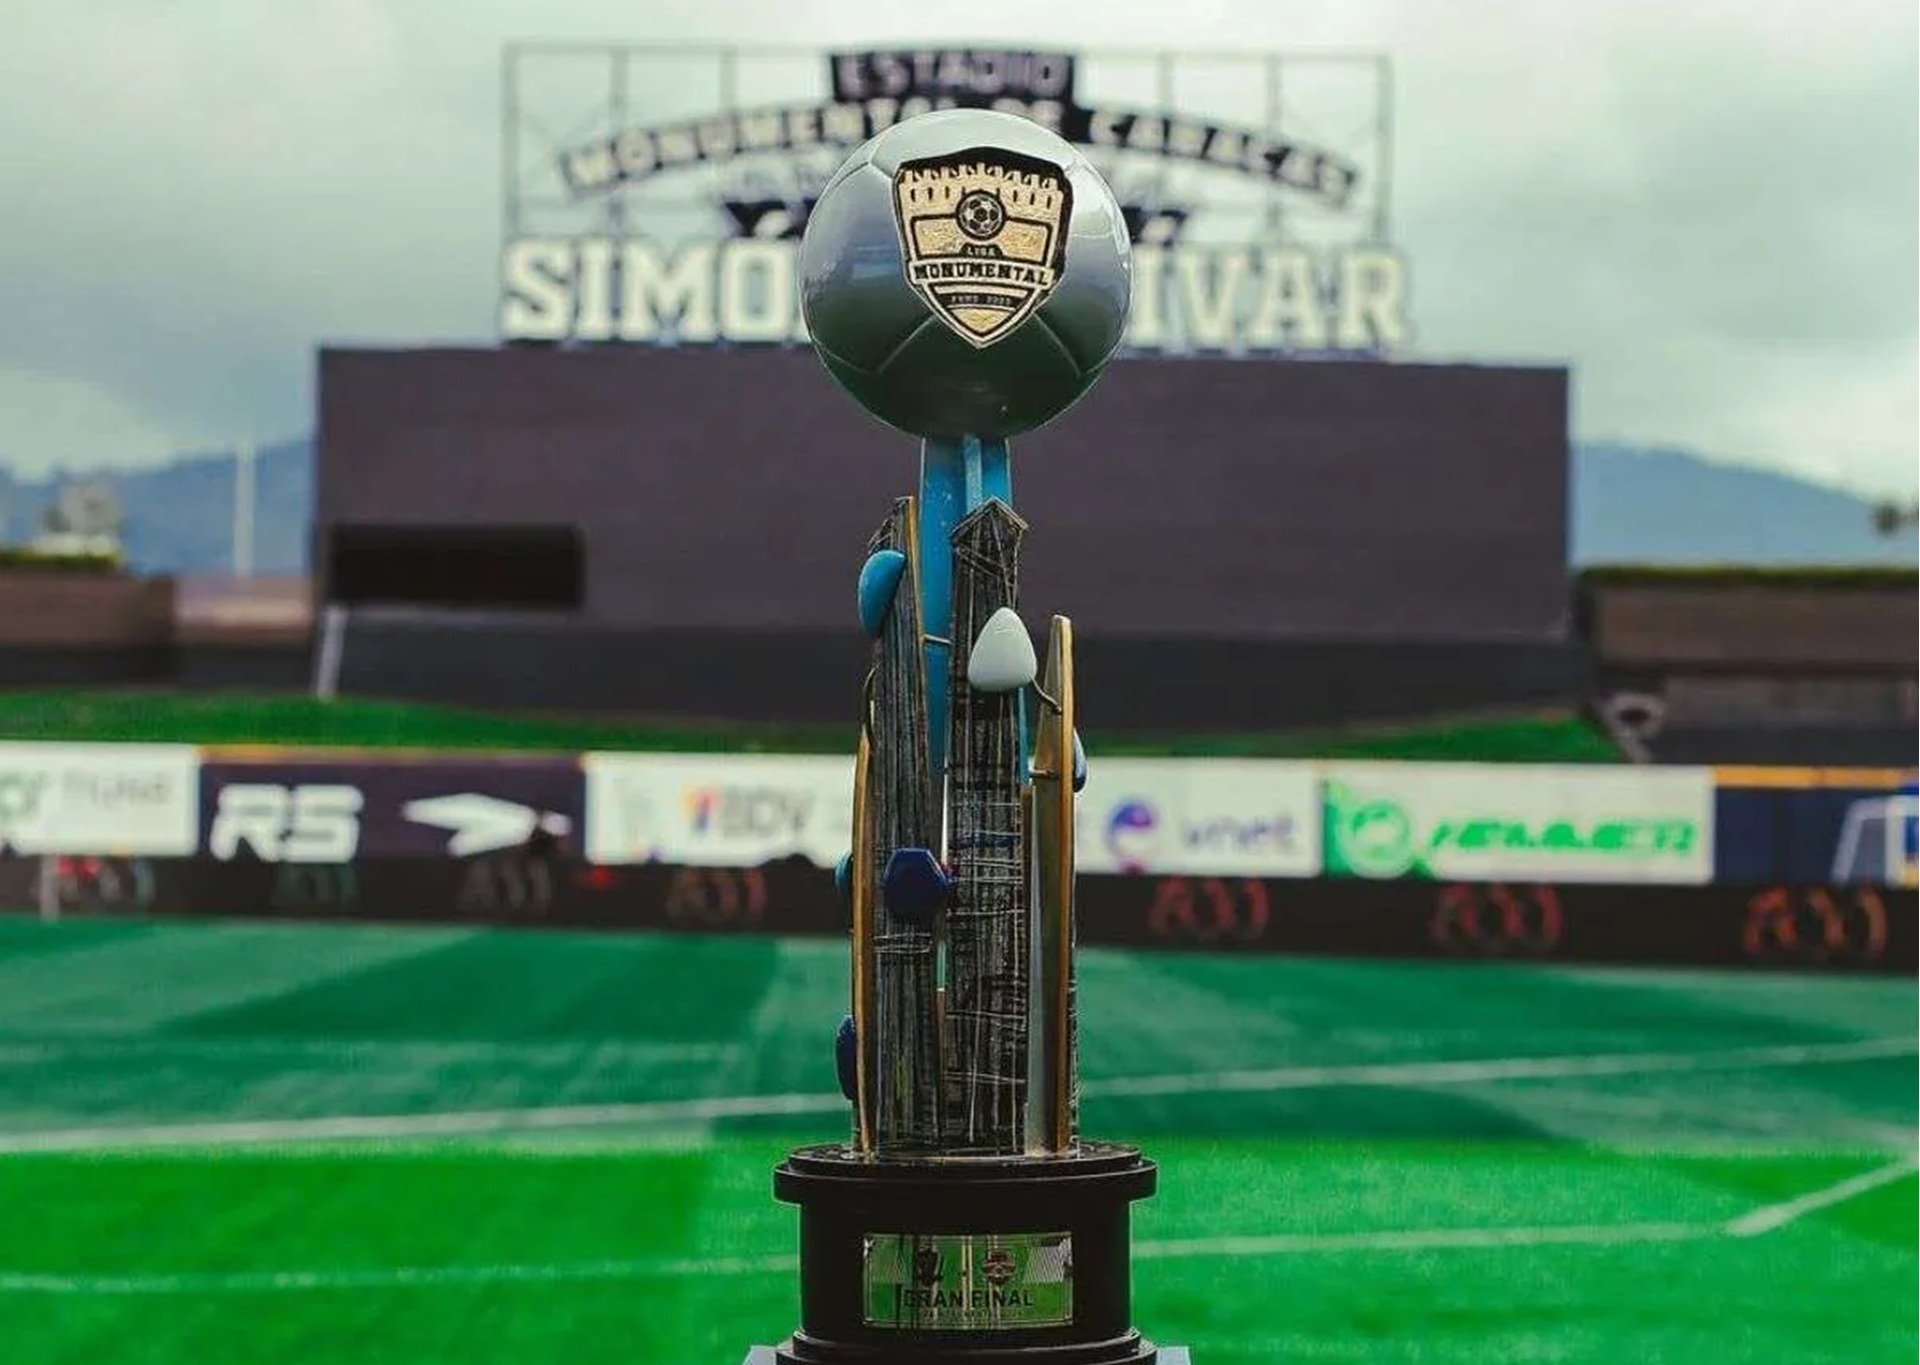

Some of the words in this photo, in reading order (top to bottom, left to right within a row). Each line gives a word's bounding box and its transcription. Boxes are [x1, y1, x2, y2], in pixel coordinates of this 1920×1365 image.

[838, 52, 1068, 98] ESTADIO
[567, 97, 957, 188] MONUMENT
[913, 262, 1049, 286] MONUMENTAL
[966, 246, 996, 257] LIGA
[503, 208, 804, 342] SIMÓ
[1128, 216, 1408, 346] ÍVAR
[210, 784, 364, 863] RS
[902, 1289, 963, 1308] GRAN
[971, 1289, 1034, 1308] FINAL
